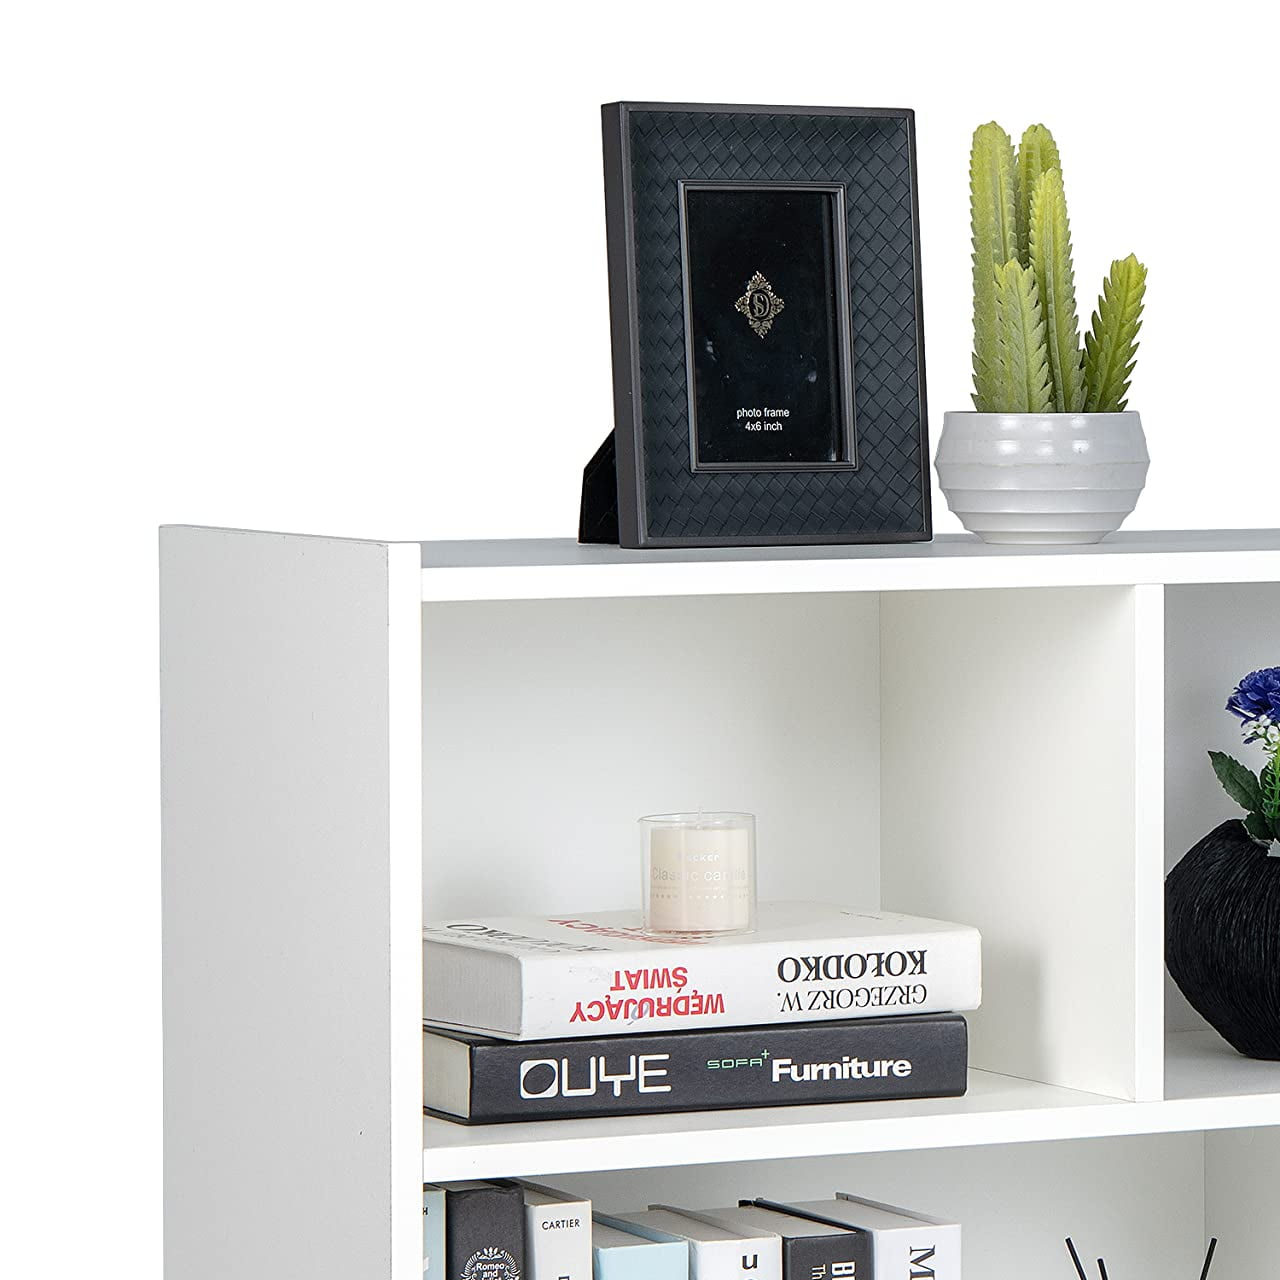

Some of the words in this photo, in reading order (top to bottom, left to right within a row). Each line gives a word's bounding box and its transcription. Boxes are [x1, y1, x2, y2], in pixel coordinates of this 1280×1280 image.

[736, 408, 762, 419] photo
[763, 408, 790, 418] frame
[745, 421, 762, 431] 4x6
[763, 421, 782, 431] inch
[778, 949, 928, 983] KOŁODKO
[610, 966, 688, 993] ŚWIAT
[776, 990, 801, 1013] W.
[807, 983, 928, 1011] GRZEGORZ
[771, 1056, 912, 1083] Furniture
[541, 1218, 580, 1231] CARTIER
[476, 1262, 505, 1271] Romeo
[482, 1270, 498, 1278] and
